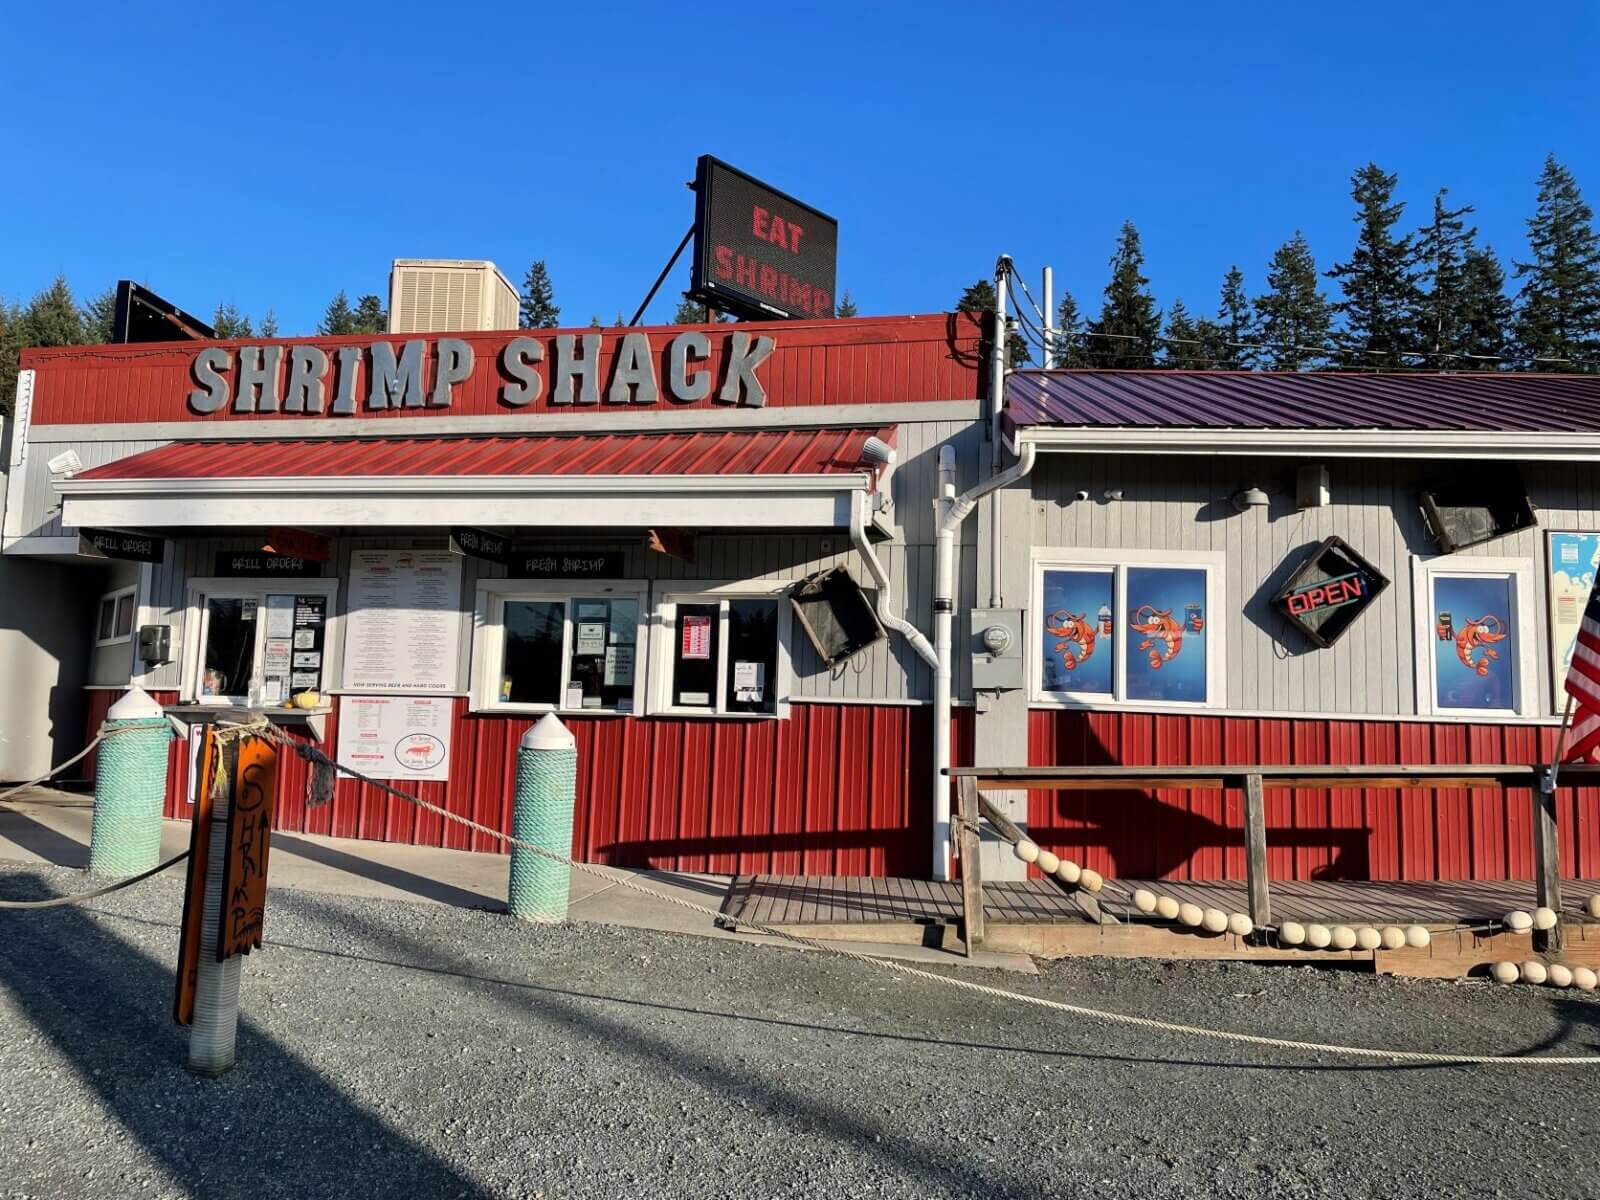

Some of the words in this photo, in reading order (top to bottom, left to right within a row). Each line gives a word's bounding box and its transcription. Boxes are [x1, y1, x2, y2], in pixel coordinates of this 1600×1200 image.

[752, 204, 804, 255] EAT
[714, 244, 831, 314] SHRIMP
[189, 338, 475, 416] SHRIMP
[498, 330, 777, 408] SHACK
[94, 536, 118, 551] GRILL
[122, 540, 152, 554] ORDERS
[231, 557, 261, 570] GRILL
[266, 557, 304, 570] ORDERS
[525, 557, 558, 572] FRESH
[561, 556, 606, 573] SHRIMP
[1287, 577, 1361, 615] OPEN
